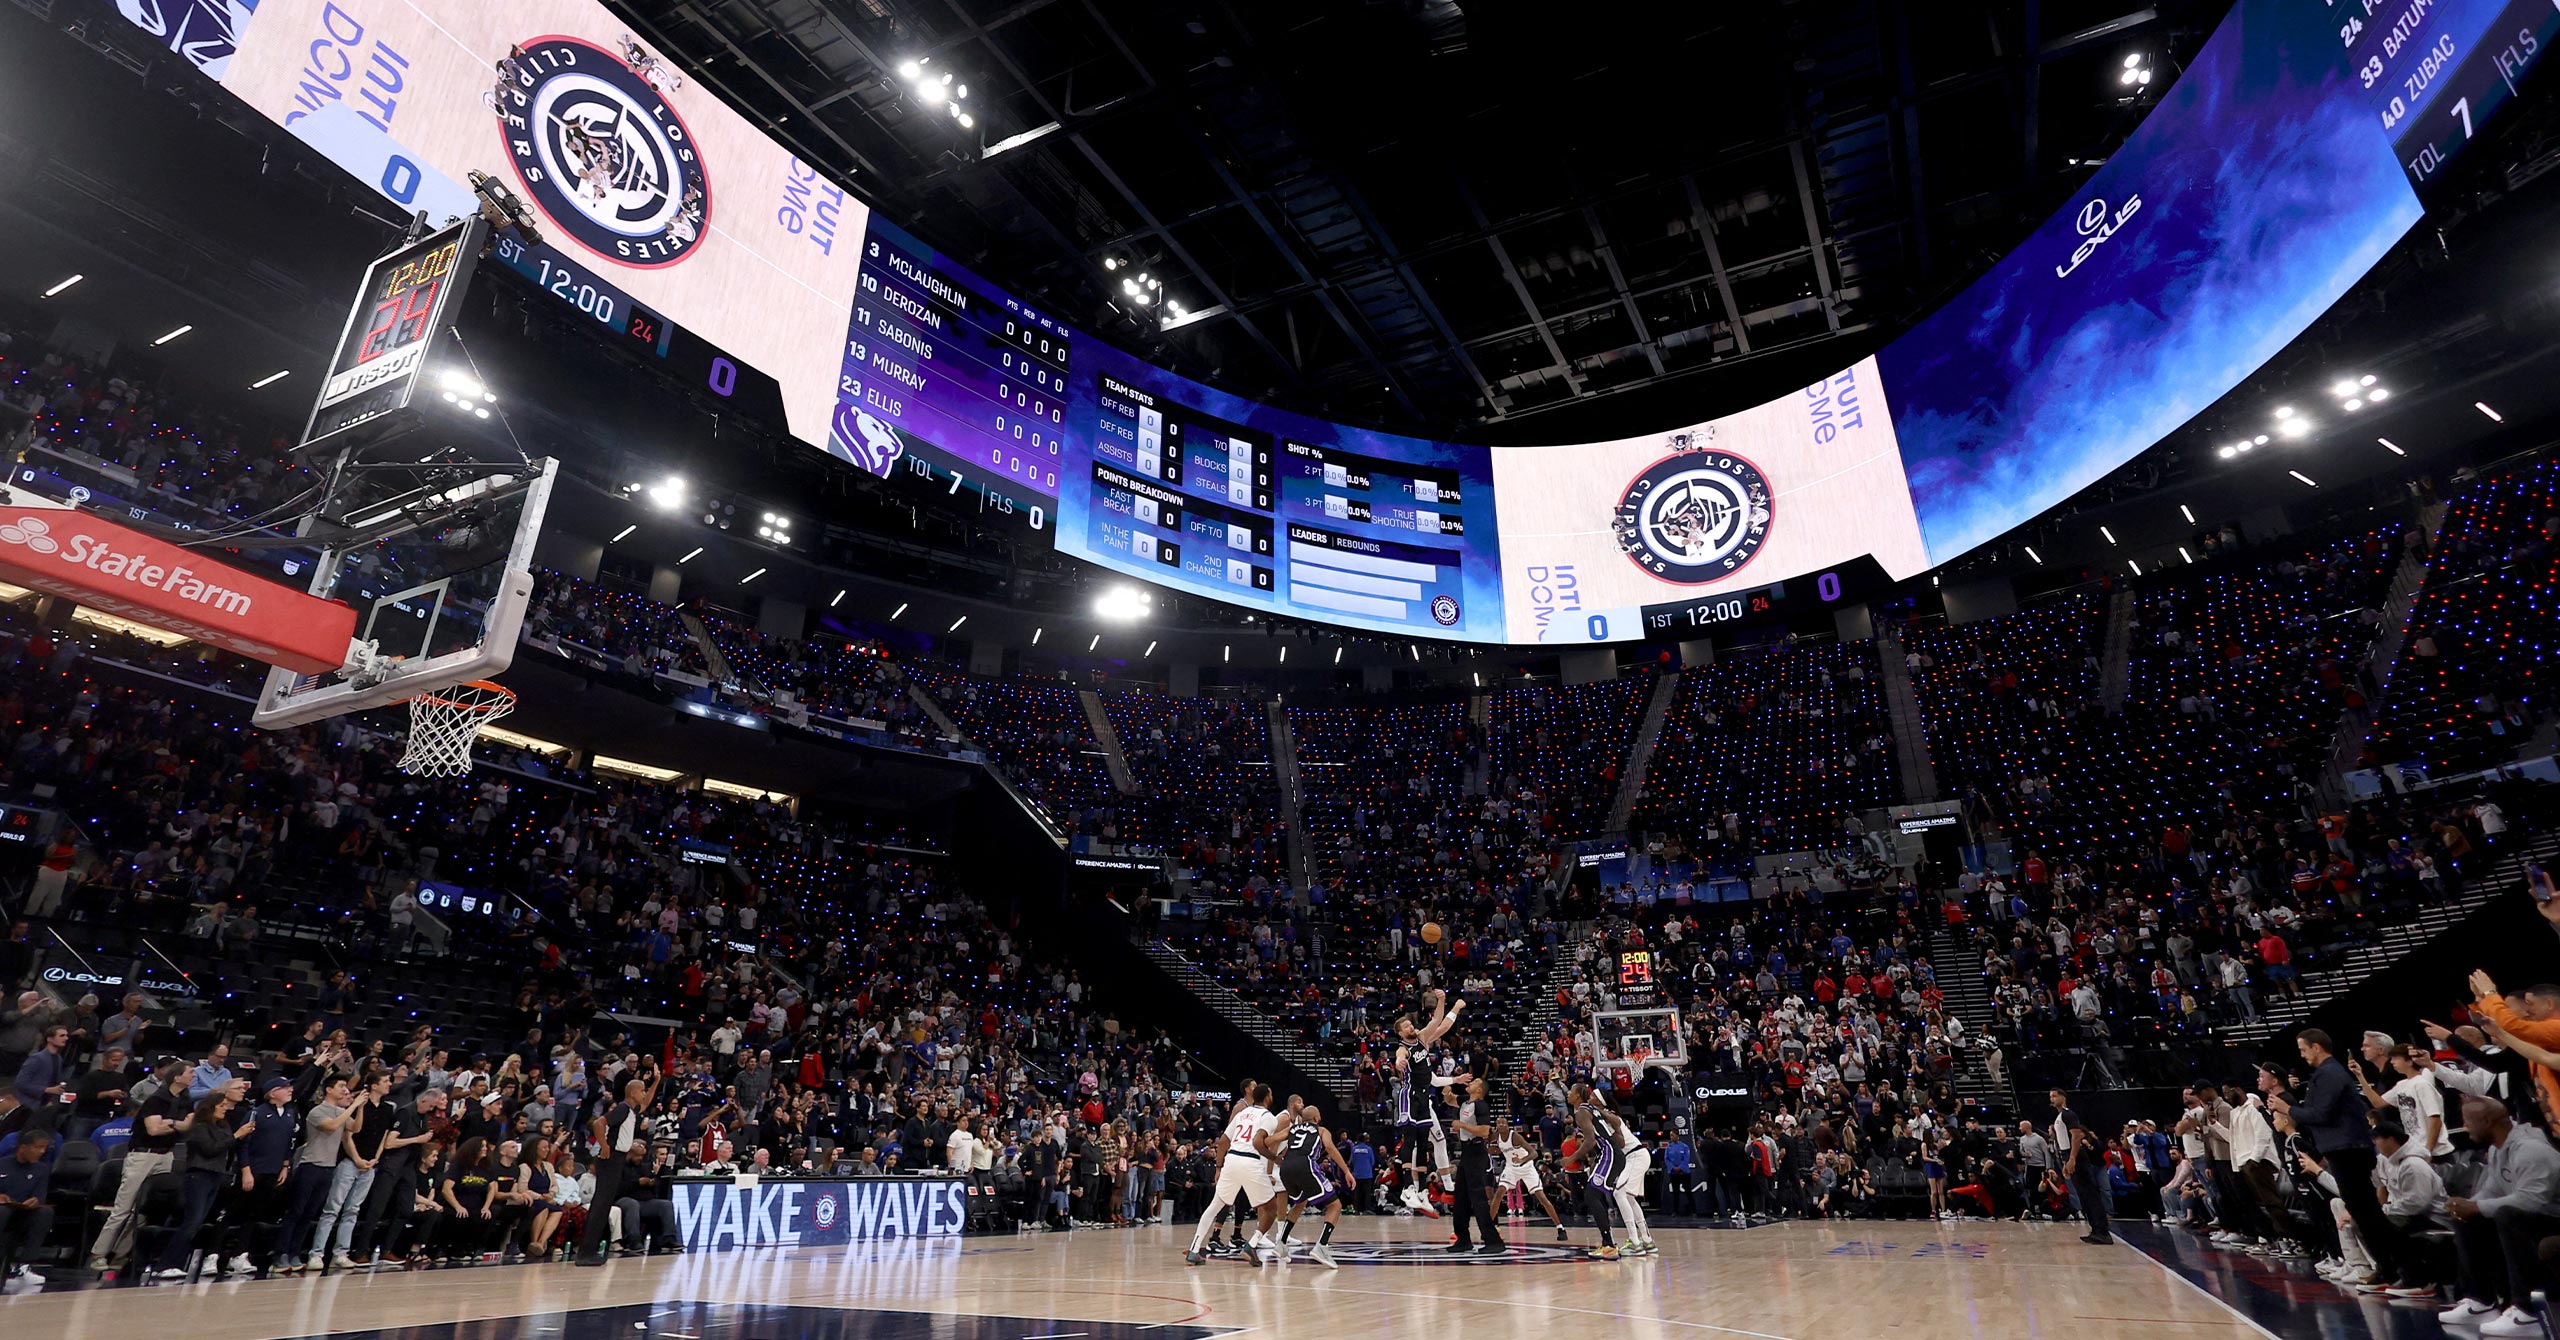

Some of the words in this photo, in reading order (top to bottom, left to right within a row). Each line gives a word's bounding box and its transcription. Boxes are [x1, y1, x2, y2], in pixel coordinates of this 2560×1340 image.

[2340, 16, 2363, 48] 24
[2360, 55, 2384, 89] 33
[2382, 0, 2434, 59] BATUM
[2382, 96, 2406, 130] 40
[2404, 34, 2455, 102] ZUBAC
[509, 48, 576, 183] CLIPPERS
[2409, 142, 2446, 182] TOL
[2451, 96, 2472, 139] 7
[2500, 28, 2538, 78] FLS
[653, 104, 694, 162] LOS
[380, 154, 421, 205] 0
[2057, 194, 2142, 278] LEXUS
[386, 243, 457, 299] 12:00
[495, 233, 525, 264] ST
[539, 259, 614, 323] 12:00
[631, 318, 652, 343] 24
[869, 242, 879, 257] 3
[889, 253, 967, 309] MCLAUGHLIN
[1006, 322, 1014, 335] 0
[1024, 331, 1031, 344] 0
[1041, 340, 1048, 353] 0
[1058, 348, 1065, 362] 0
[358, 281, 438, 364] 24
[861, 273, 877, 292] 10
[883, 286, 941, 330] DEROZAN
[1003, 353, 1011, 367] 0
[1021, 362, 1028, 376] 0
[1038, 371, 1045, 384] 0
[1055, 379, 1063, 392] 0
[1007, 299, 1018, 311] PTS
[1024, 308, 1035, 320] REB
[1041, 318, 1052, 328] AST
[1058, 326, 1069, 337] FLS
[352, 350, 418, 389] TISSOT
[708, 357, 737, 397] 0
[857, 307, 871, 326] 11
[878, 320, 932, 359] SABONIS
[1000, 384, 1008, 398] 0
[1017, 393, 1025, 407] 0
[1035, 401, 1043, 415] 0
[1053, 409, 1060, 423] 0
[849, 340, 865, 360] 13
[872, 353, 926, 391] MURRAY
[996, 416, 1004, 431] 0
[1014, 425, 1022, 439] 0
[1032, 434, 1040, 447] 0
[1050, 442, 1057, 455] 0
[1105, 379, 1128, 396] TEAM
[1129, 389, 1153, 406] STATS
[1101, 397, 1117, 410] OFF
[1119, 404, 1134, 418] REB
[1147, 415, 1154, 426] 0
[1170, 424, 1177, 435] 0
[841, 375, 862, 396] 23
[867, 388, 902, 417] ELLIS
[993, 450, 1000, 464] 0
[1011, 458, 1019, 472] 0
[1029, 466, 1037, 479] 0
[1047, 473, 1055, 487] 0
[1100, 419, 1116, 432] DEF
[1118, 427, 1133, 440] REB
[1146, 438, 1152, 448] 0
[1169, 446, 1176, 457] 0
[1098, 442, 1132, 462] ASSISTS
[1145, 459, 1151, 470] 0
[1168, 468, 1175, 479] 0
[1214, 439, 1227, 451] T/O
[1237, 447, 1243, 456] 0
[1260, 453, 1266, 464] 0
[1288, 443, 1309, 455] SHOT
[1312, 448, 1323, 459] %
[1705, 455, 1744, 475] LOS
[22, 470, 35, 482] 0
[1194, 456, 1227, 473] BLOCKS
[1237, 469, 1243, 478] 0
[1260, 475, 1266, 485] 0
[1305, 466, 1310, 475] 2
[1312, 468, 1322, 476] PT
[909, 454, 933, 481] TOL
[949, 470, 963, 495] 7
[990, 491, 1013, 514] FLS
[1029, 505, 1044, 530] 0
[1098, 468, 1128, 487] POINTS
[1130, 480, 1183, 506] BREAKDOWN
[1110, 489, 1132, 503] FAST
[1195, 478, 1226, 494] STEALS
[1237, 490, 1243, 499] 0
[1259, 496, 1266, 507] 0
[1403, 485, 1413, 493] FT
[128, 506, 148, 521] 1ST
[1104, 498, 1130, 514] BREAK
[1143, 506, 1149, 517] 0
[1166, 513, 1174, 525] 0
[1305, 498, 1311, 507] 3
[1312, 500, 1323, 509] PT
[1393, 509, 1415, 520] TRUE
[1102, 522, 1111, 533] IN
[1112, 527, 1129, 539] THE
[1190, 521, 1206, 534] OFF
[1208, 526, 1222, 538] T/O
[1236, 534, 1243, 544] 0
[1259, 540, 1266, 551] 0
[1372, 516, 1415, 530] SHOOTING
[1623, 479, 1666, 573] CLIPPERS
[1104, 535, 1129, 551] PAINT
[1141, 541, 1148, 552] 0
[1165, 549, 1173, 560] 0
[1292, 528, 1327, 543] LEADERS
[1337, 538, 1380, 553] REBOUNDS
[60, 534, 251, 617] StateFarm
[1186, 562, 1222, 579] CHANCE
[1236, 569, 1242, 579] 0
[1259, 574, 1266, 585] 0
[1204, 555, 1222, 567] 2ND
[1818, 572, 1841, 601] 0
[417, 608, 425, 618] 0
[1650, 613, 1673, 628] 1ST
[1687, 600, 1743, 626] 12:00
[1753, 597, 1769, 612] 24
[1588, 615, 1608, 640] 0
[483, 901, 493, 914] 0
[1622, 952, 1647, 963] 12:00
[1622, 964, 1648, 983] 24
[1710, 1088, 1747, 1096] LEXUS
[1233, 1125, 1253, 1143] 24
[1291, 1133, 1307, 1149] 3
[672, 1183, 804, 1248] MAKE
[846, 1182, 965, 1238] WAVES
